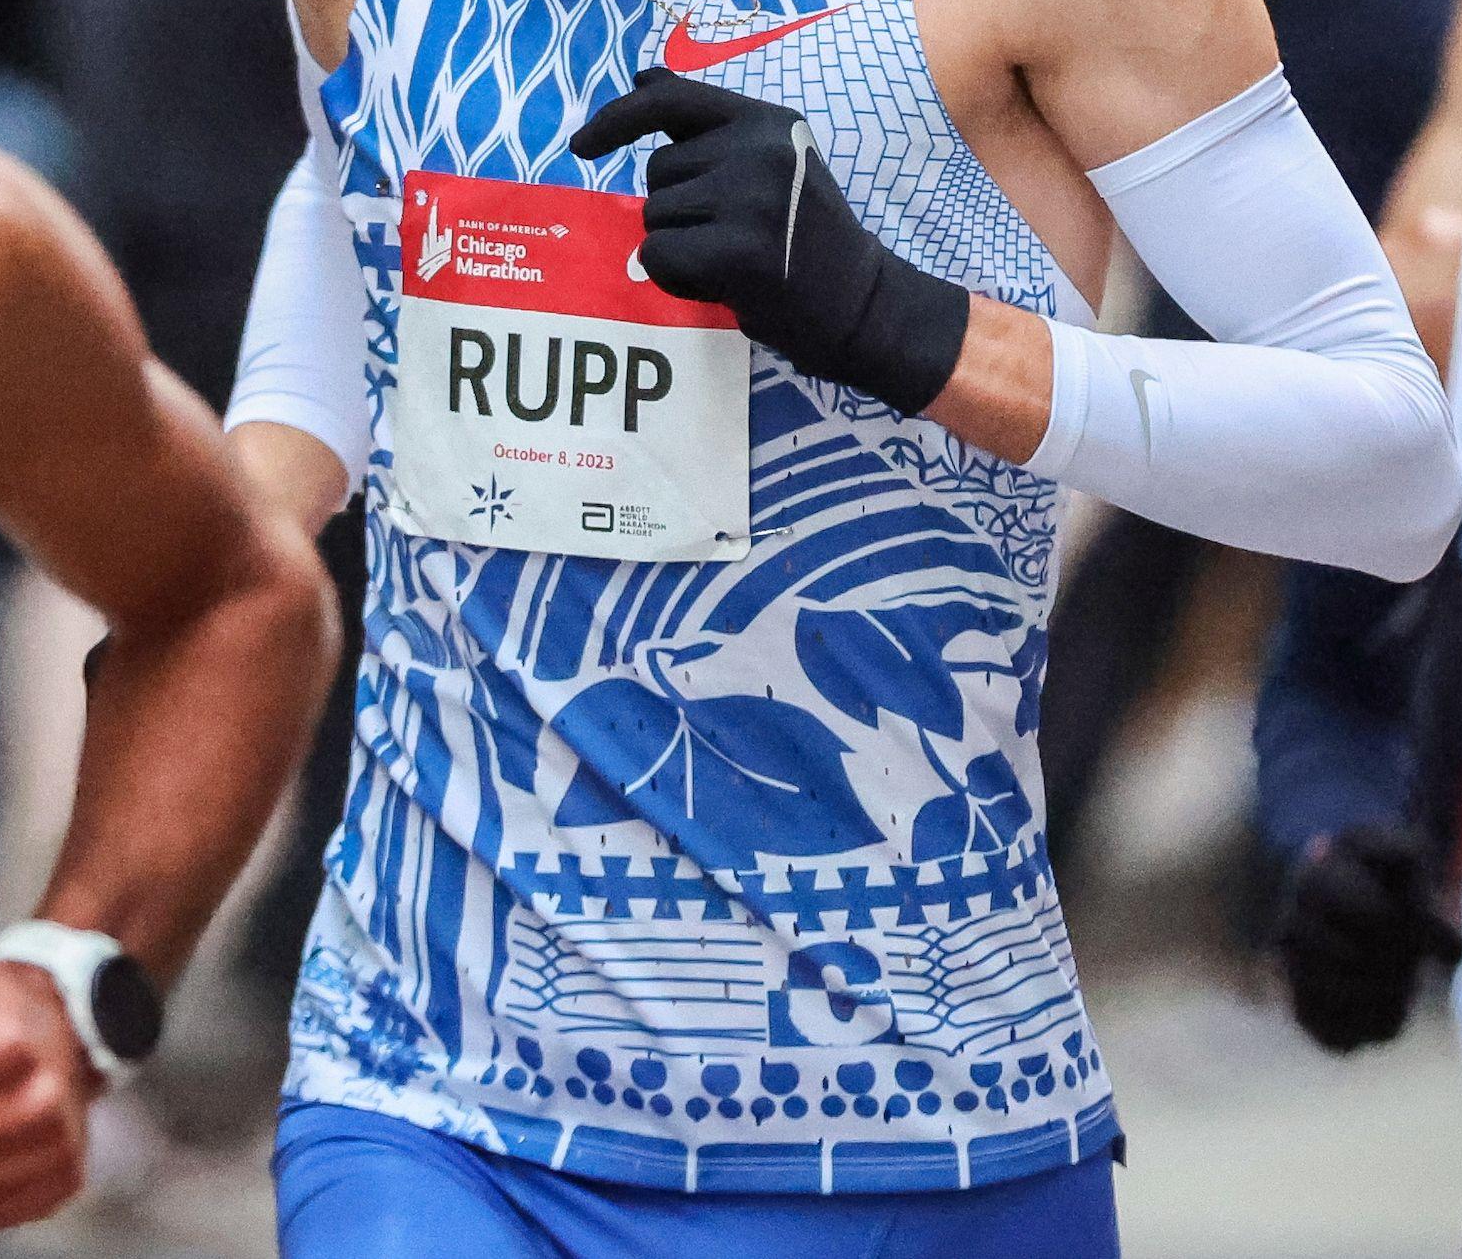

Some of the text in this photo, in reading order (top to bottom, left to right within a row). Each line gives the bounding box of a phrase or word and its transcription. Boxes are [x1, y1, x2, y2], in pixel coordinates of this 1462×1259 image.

[458, 219, 548, 236] BANK OF AMERICA
[457, 234, 527, 262] Chicago
[456, 255, 543, 282] Marathon
[449, 326, 674, 433] RUPP
[494, 443, 614, 470] October 8, 2023
